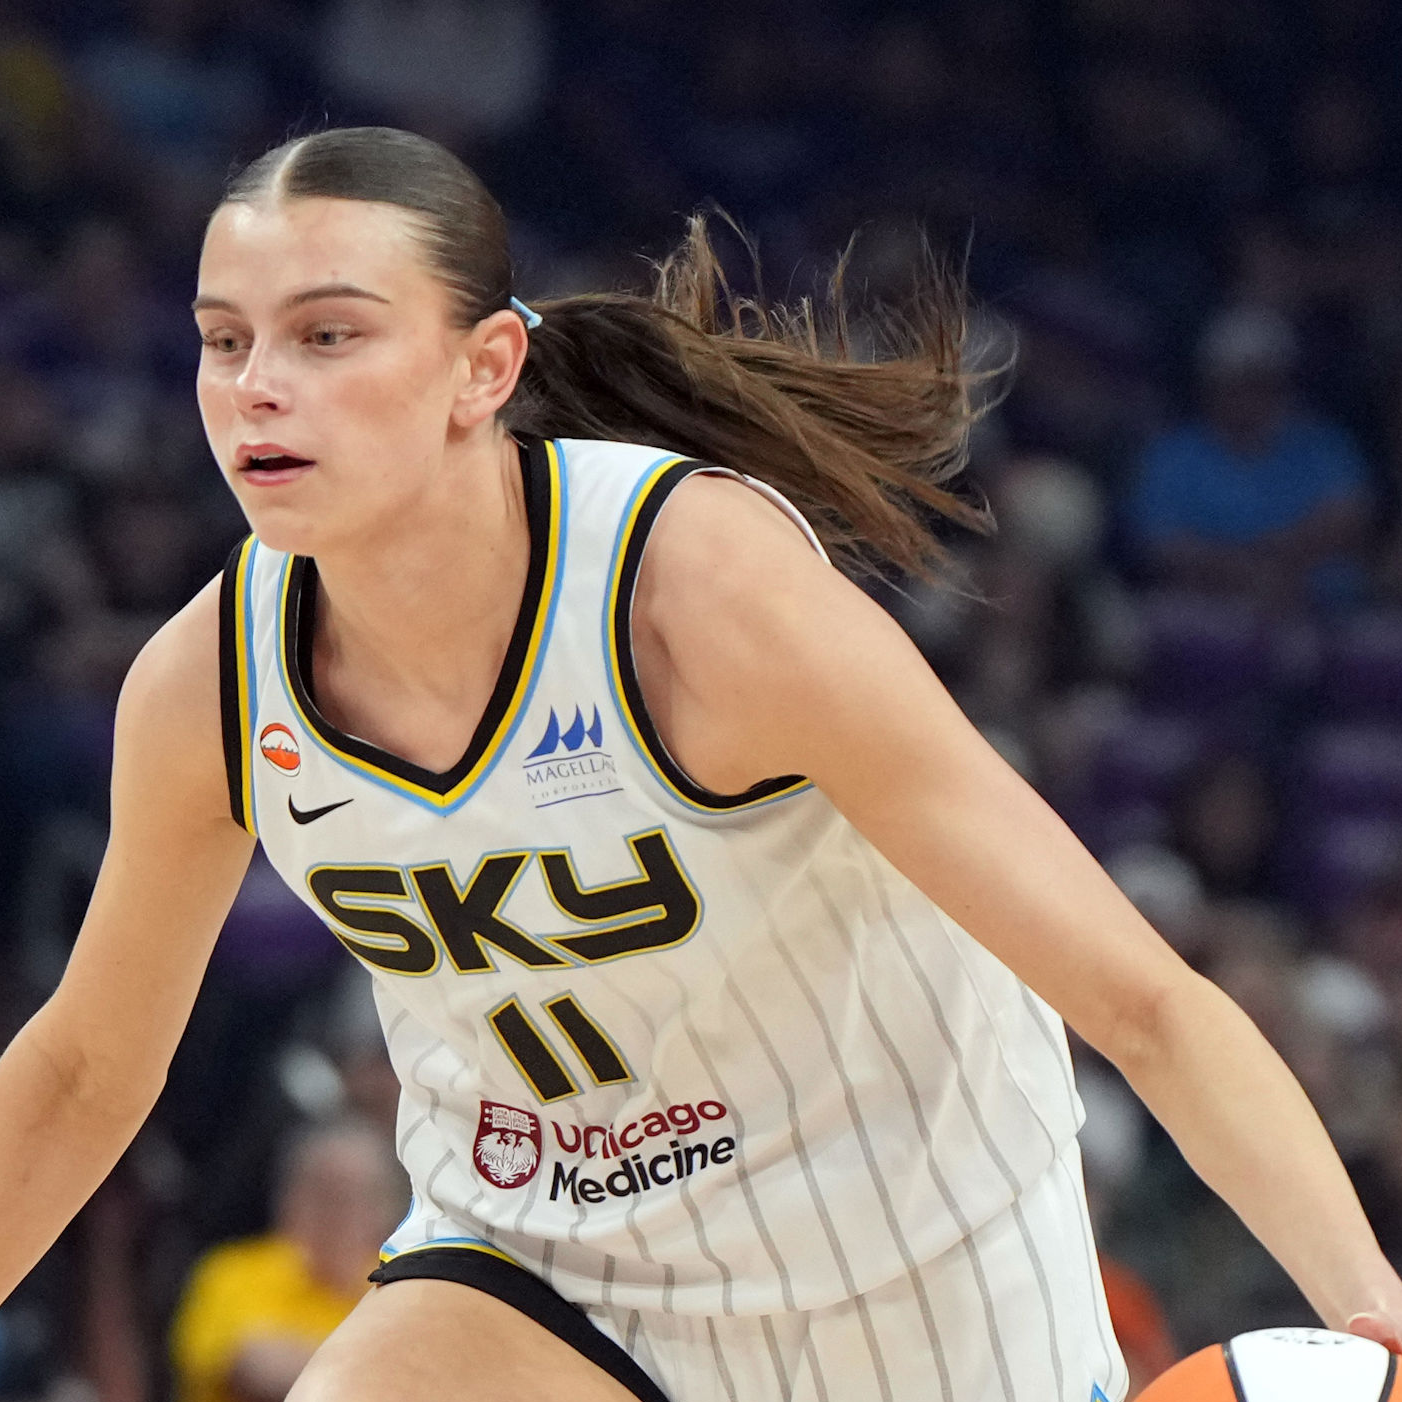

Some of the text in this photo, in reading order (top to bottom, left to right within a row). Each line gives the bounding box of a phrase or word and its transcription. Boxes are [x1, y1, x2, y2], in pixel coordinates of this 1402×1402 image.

[306, 825, 704, 977] SKY
[484, 990, 639, 1105] 11
[549, 1136, 736, 1205] Medicine
